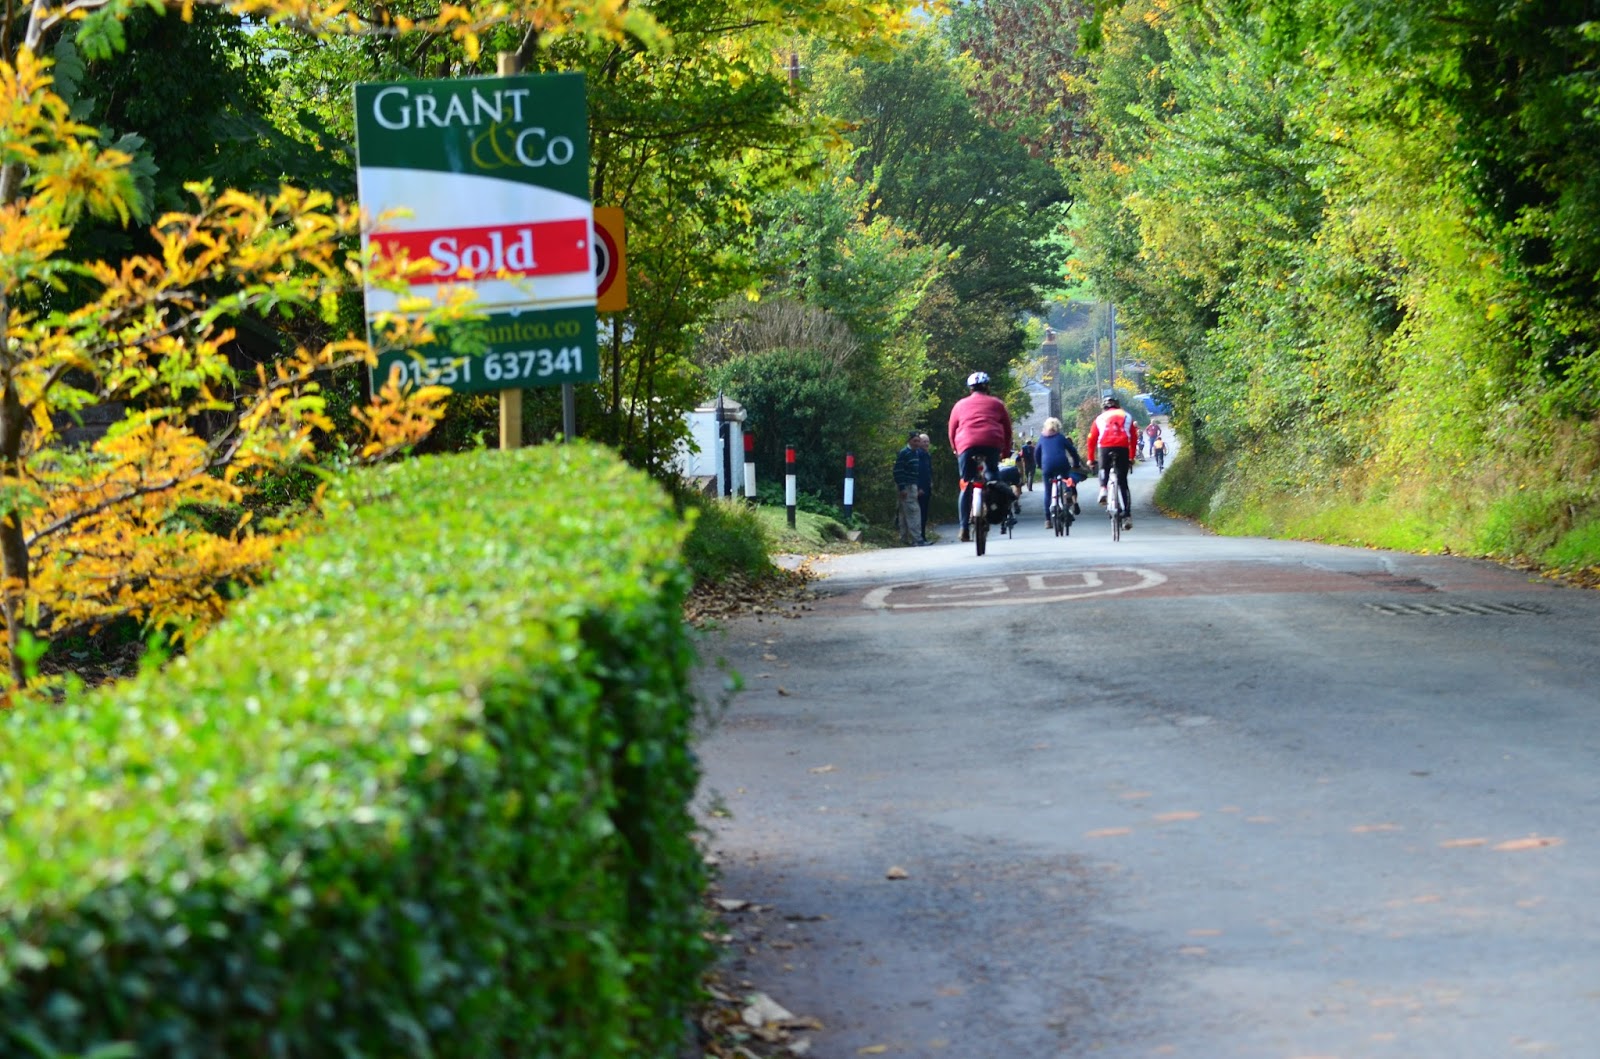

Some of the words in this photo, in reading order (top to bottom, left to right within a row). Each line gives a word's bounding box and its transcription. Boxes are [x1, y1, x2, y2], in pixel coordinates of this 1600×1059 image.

[373, 86, 530, 130] GRANT
[471, 106, 533, 169] &
[429, 229, 538, 277] Sold
[483, 345, 584, 381] 637341
